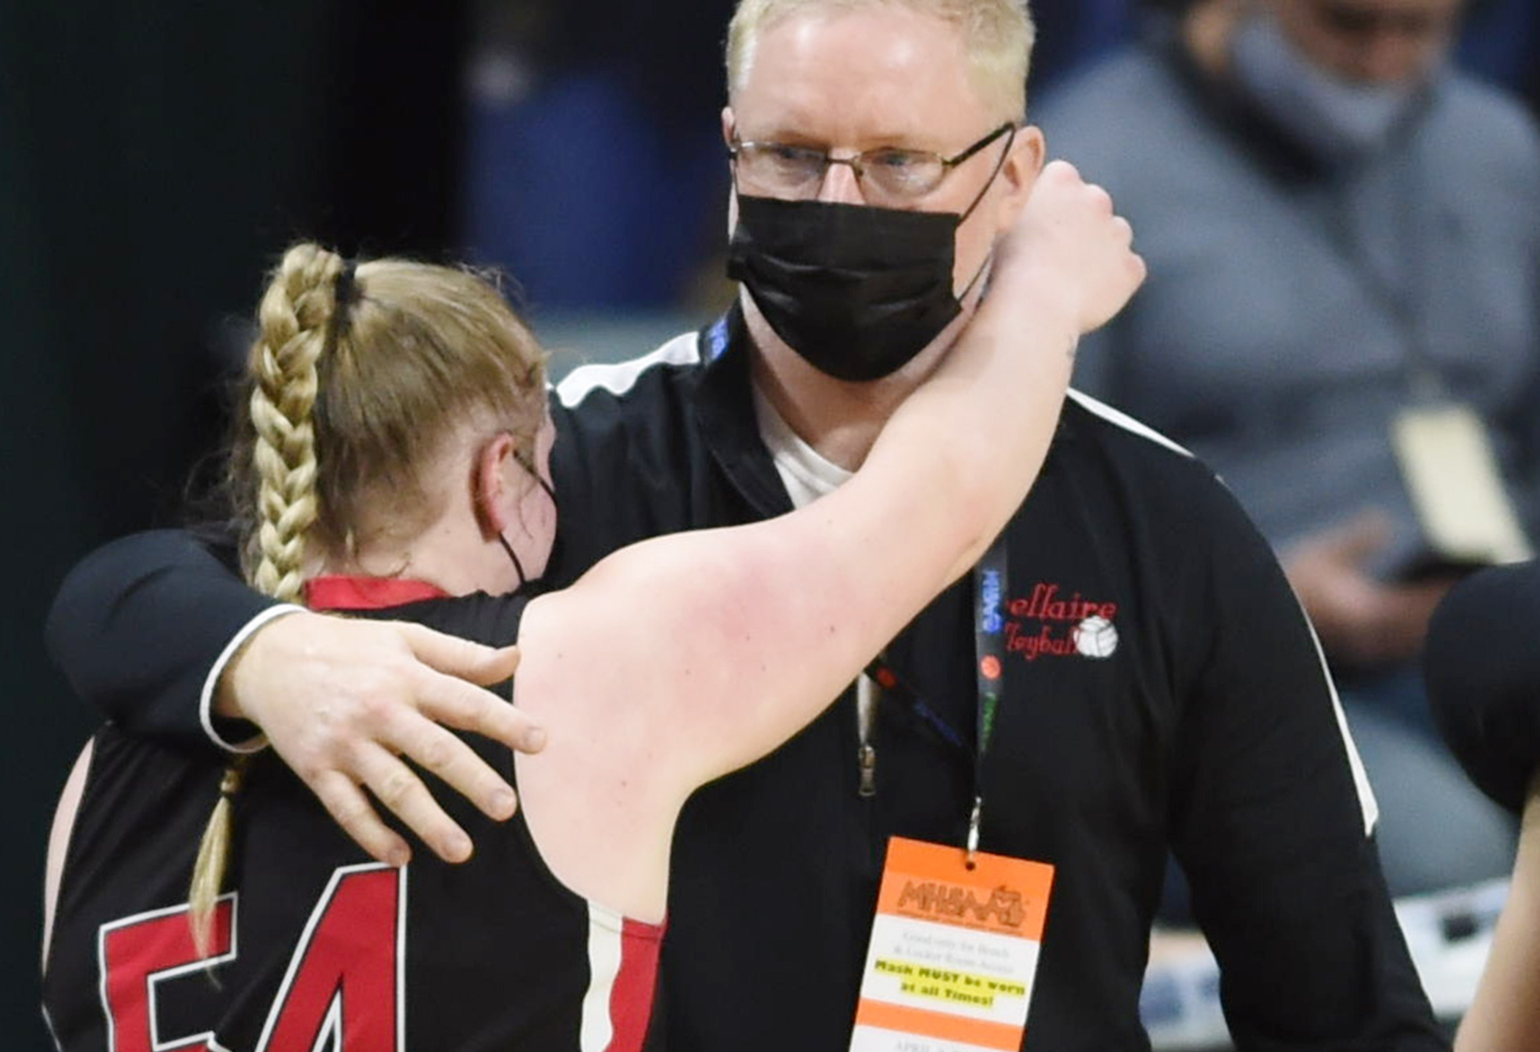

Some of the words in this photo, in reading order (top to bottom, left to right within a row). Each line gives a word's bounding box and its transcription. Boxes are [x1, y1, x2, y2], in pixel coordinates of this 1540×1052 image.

[1007, 583, 1119, 620] ellaire
[875, 960, 913, 975] Mask
[918, 966, 959, 983] MUST
[964, 974, 982, 987] be
[987, 981, 1025, 996] worn
[901, 981, 915, 993] at
[921, 984, 939, 997] all
[945, 988, 994, 1006] Times!
